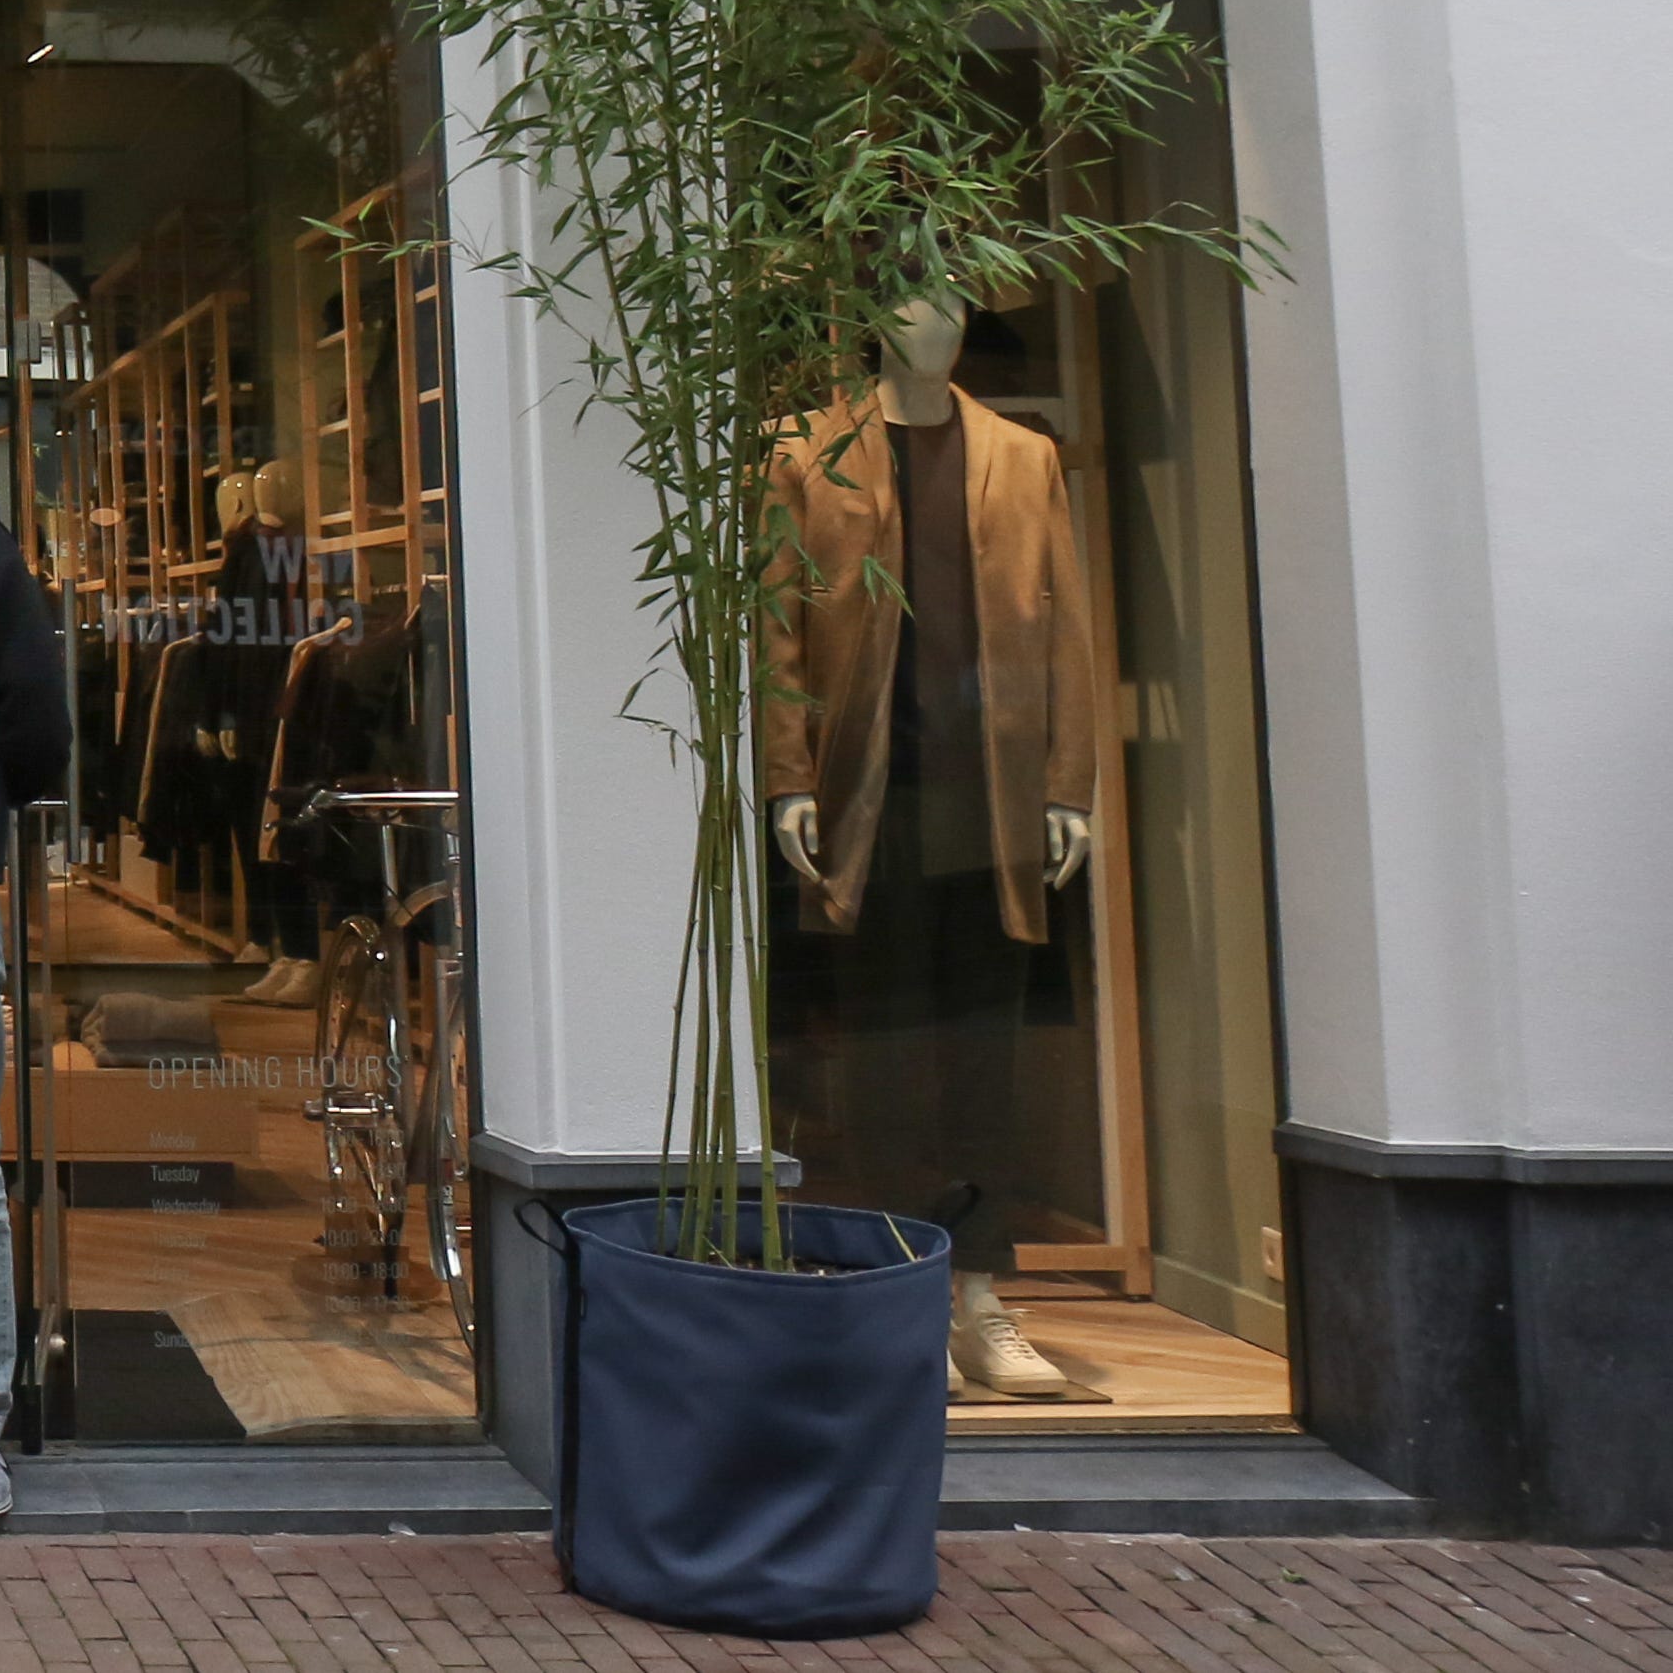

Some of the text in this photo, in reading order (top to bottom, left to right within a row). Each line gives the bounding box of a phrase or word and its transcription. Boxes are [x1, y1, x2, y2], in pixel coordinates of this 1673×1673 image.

[148, 1055, 403, 1090] OPENING HOURS
[150, 1132, 196, 1151] Monday
[151, 1165, 199, 1185] Tuesday
[152, 1198, 220, 1217] Wednesday
